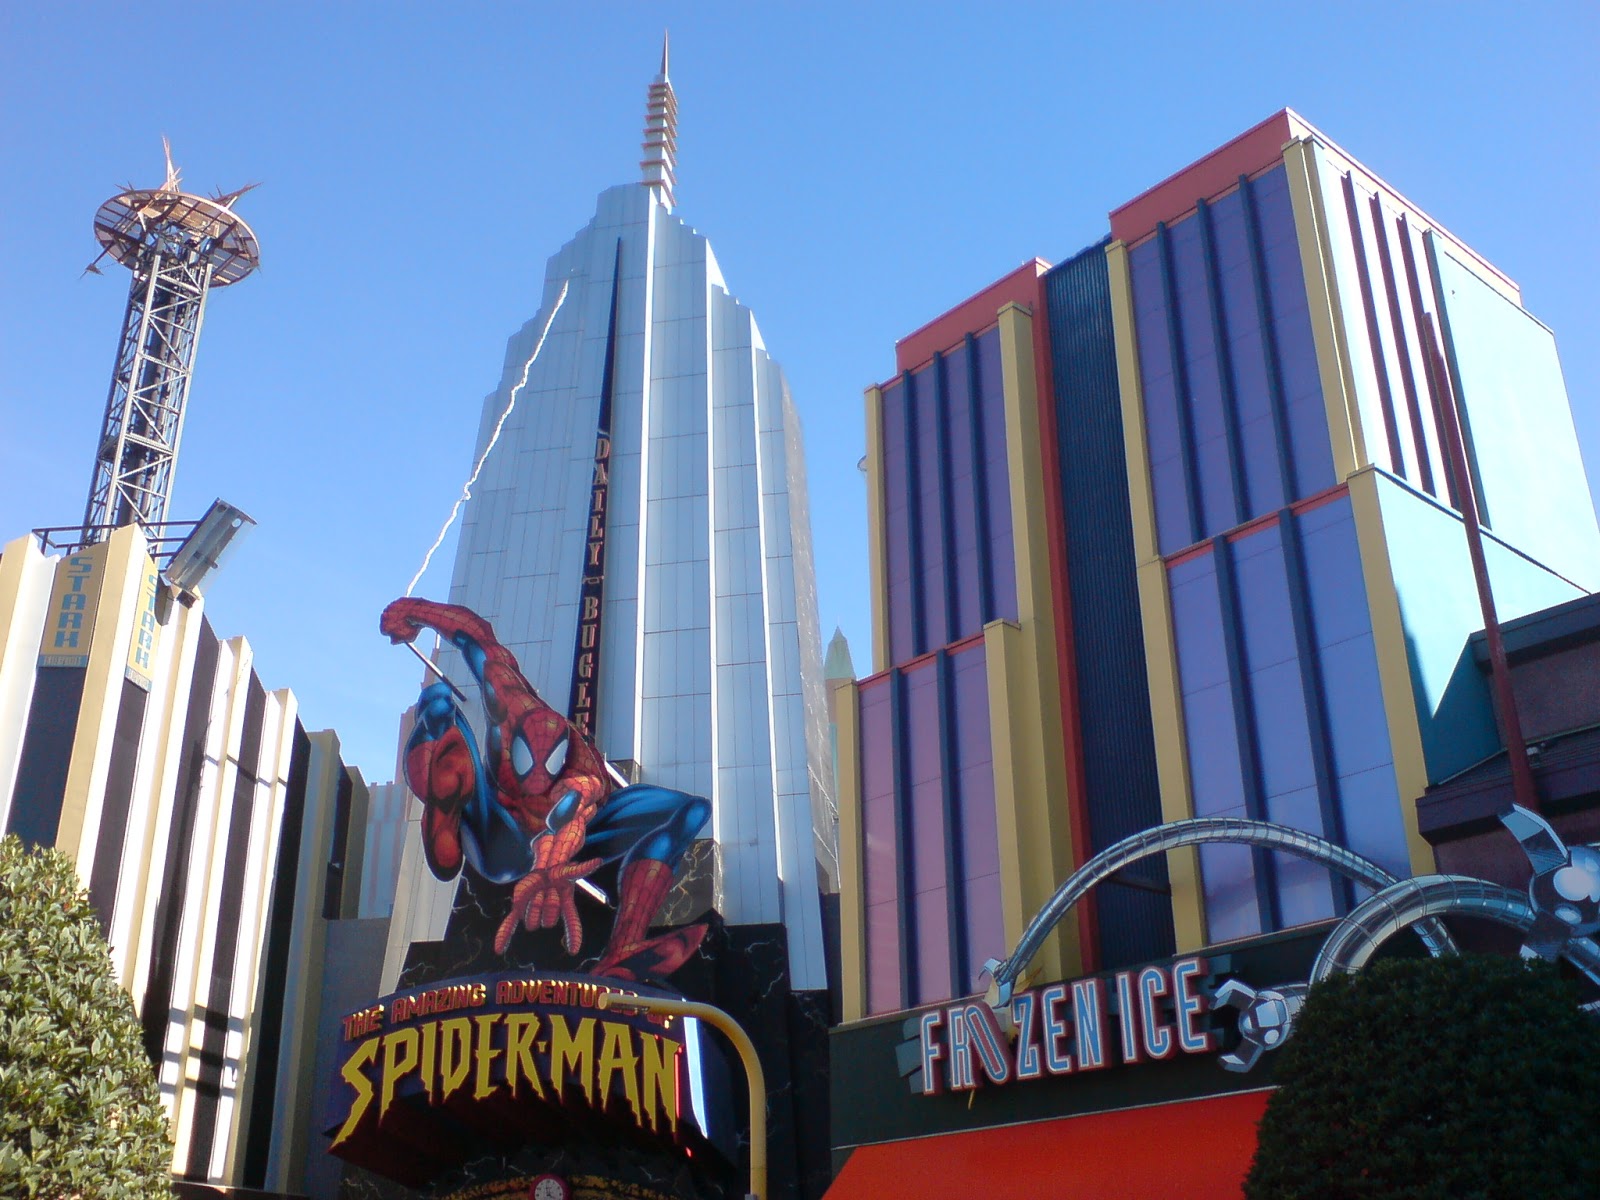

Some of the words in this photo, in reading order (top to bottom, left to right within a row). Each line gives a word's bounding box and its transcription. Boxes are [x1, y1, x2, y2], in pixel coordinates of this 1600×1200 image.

[587, 437, 609, 566] DAILY
[54, 556, 93, 649] STARK
[575, 596, 599, 736] BUGLE
[341, 1004, 386, 1042] THE
[390, 983, 487, 1024] AMAZING
[919, 976, 1107, 1096] FROZEN
[1115, 957, 1211, 1064] ICE
[328, 1011, 682, 1150] SPIDER-MAN
